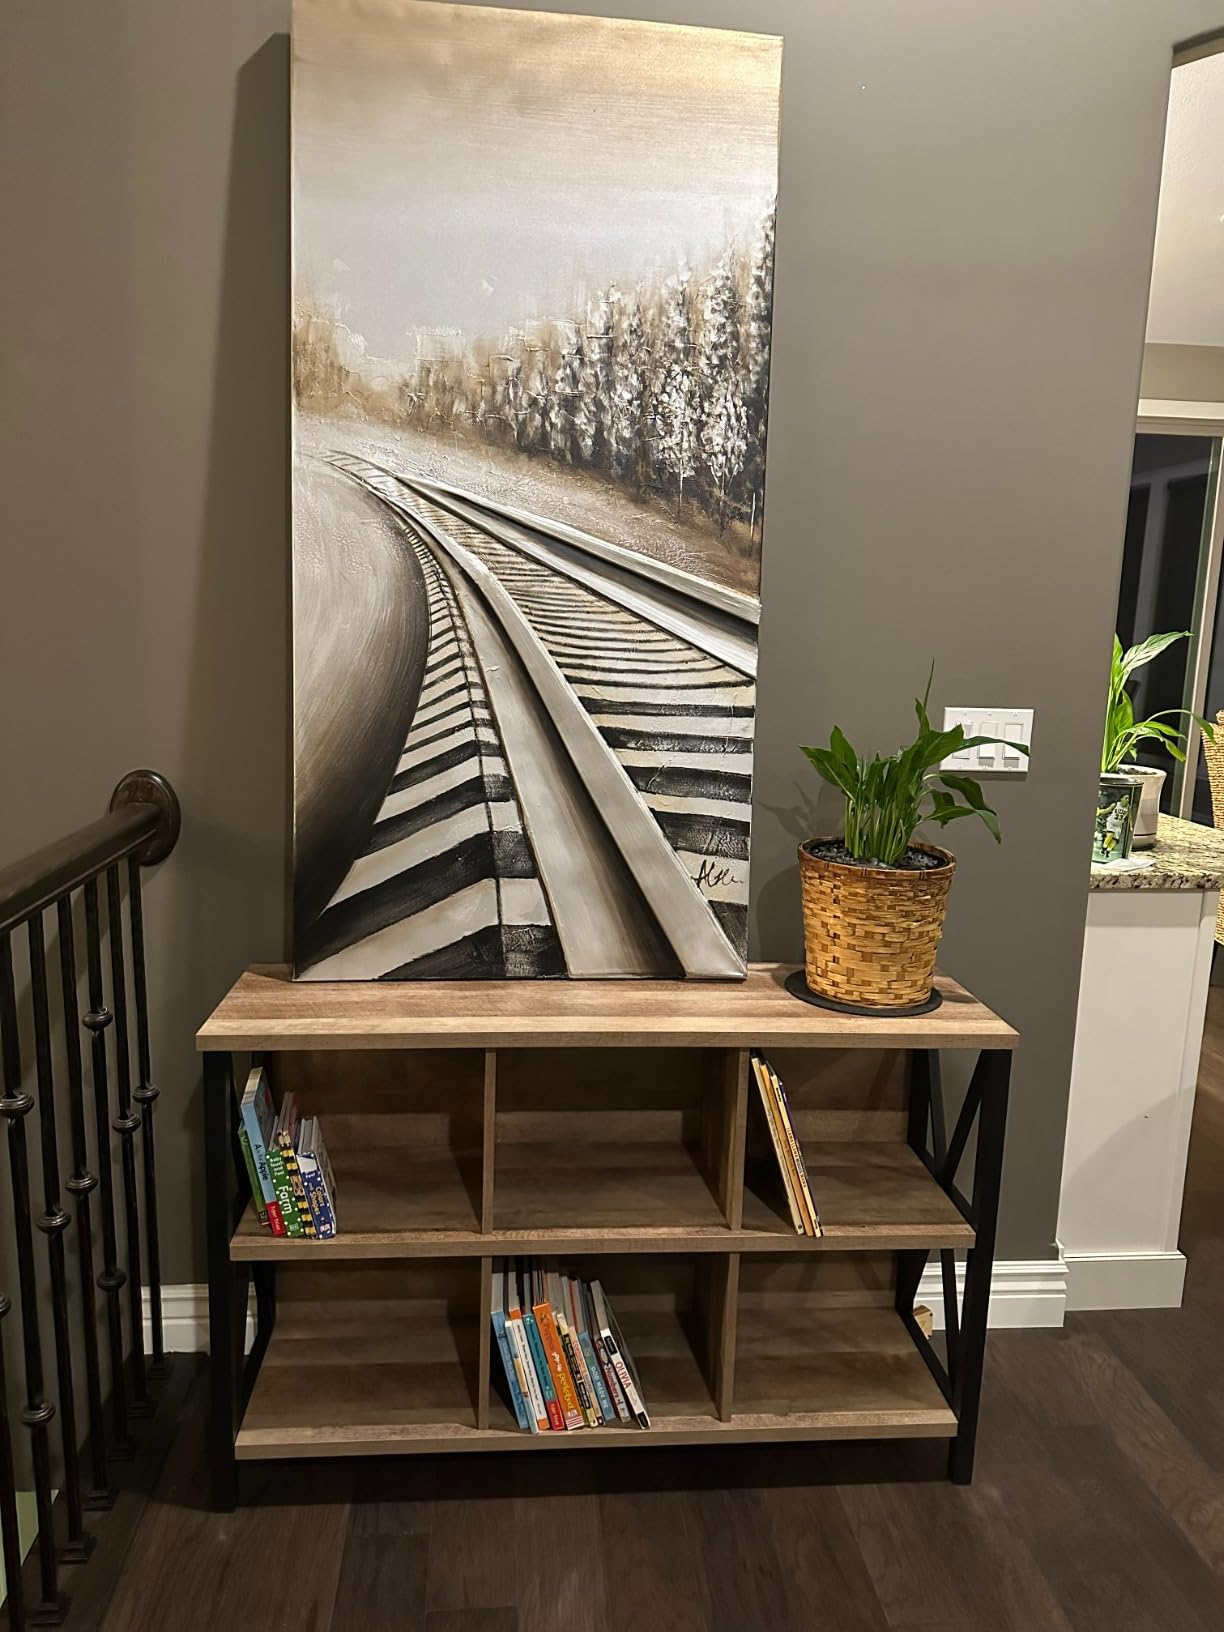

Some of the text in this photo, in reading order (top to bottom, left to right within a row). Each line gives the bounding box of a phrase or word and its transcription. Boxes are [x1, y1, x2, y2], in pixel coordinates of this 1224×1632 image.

[258, 1162, 269, 1180] Apple
[278, 1185, 292, 1214] Farm
[309, 1191, 320, 1215] Shapes
[316, 1186, 325, 1207] Colors
[590, 1366, 599, 1380] GOD
[596, 1381, 606, 1398] MADE
[605, 1367, 620, 1399] Numbers
[615, 1361, 632, 1389] OLIVIA
